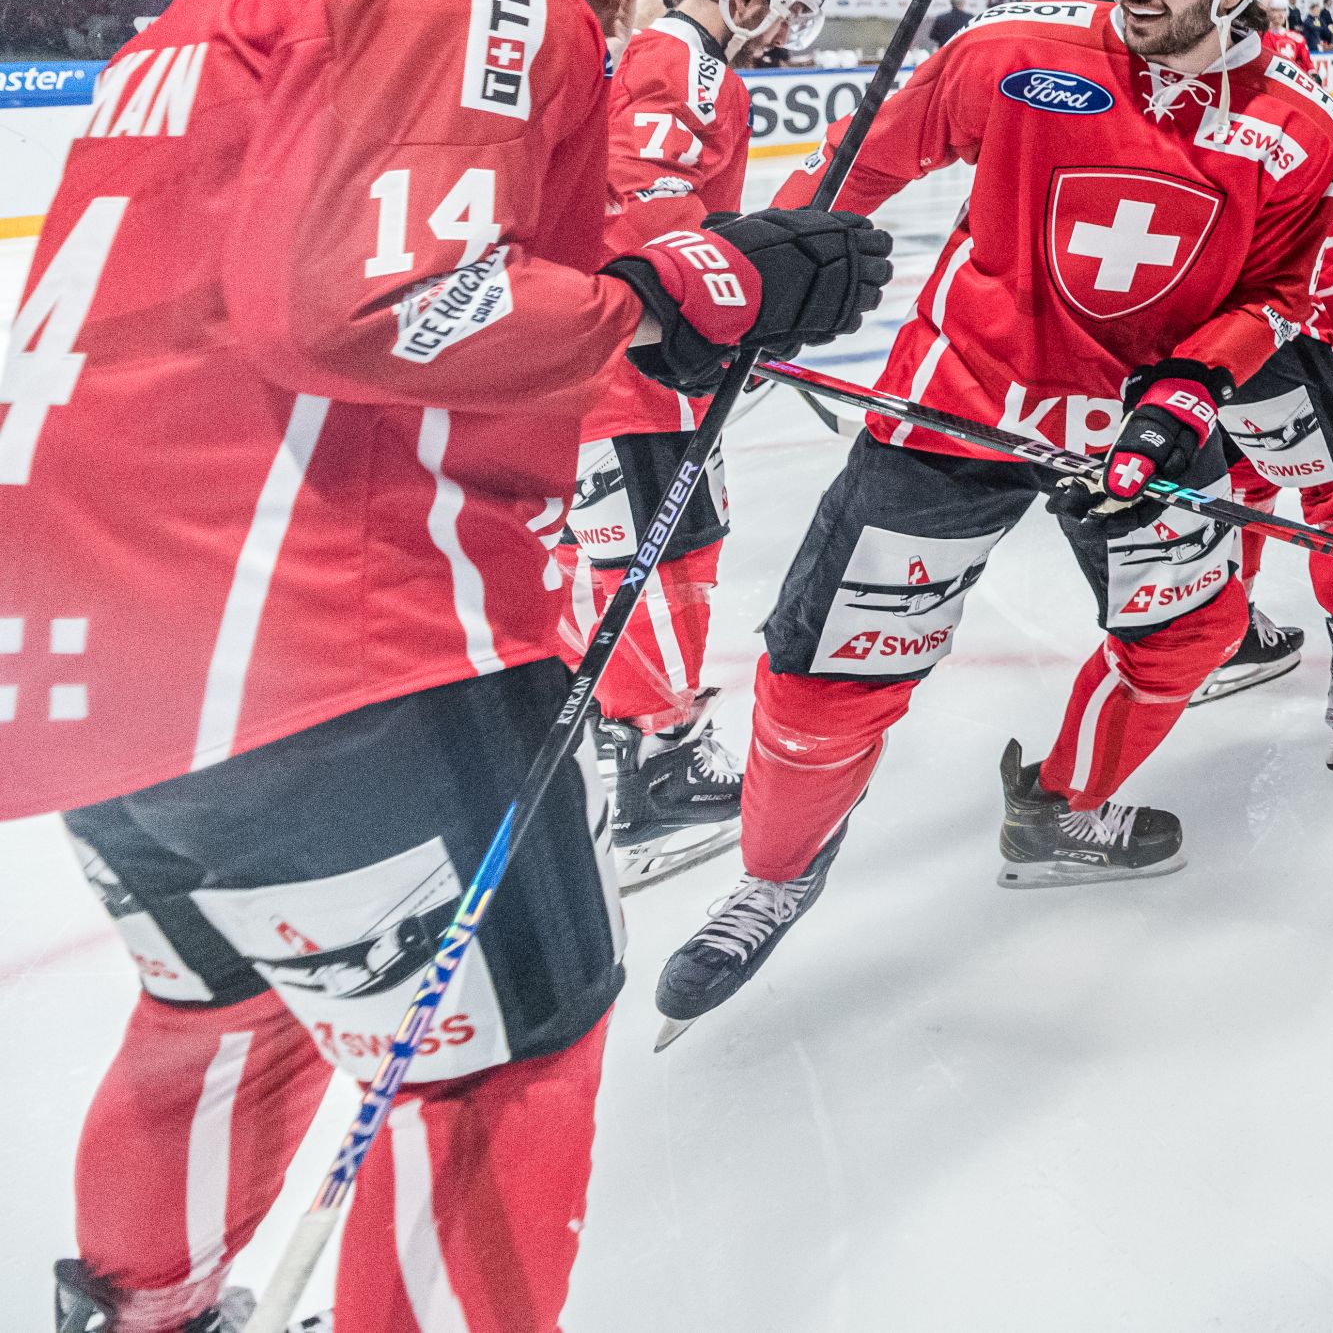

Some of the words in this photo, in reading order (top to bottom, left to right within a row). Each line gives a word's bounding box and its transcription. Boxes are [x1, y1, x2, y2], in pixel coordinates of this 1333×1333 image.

[1023, 73, 1093, 110] Ford
[1239, 127, 1295, 169] SWISS
[364, 167, 502, 279] 14
[472, 285, 504, 326] GAMES
[404, 314, 446, 358] ICE
[997, 379, 1128, 457] kp
[1272, 460, 1325, 478] SWISS
[1158, 568, 1222, 606] SWISS
[880, 625, 953, 657] SWISS
[556, 674, 594, 726] KUKAN
[1052, 849, 1100, 863] CCM
[342, 1014, 476, 1057] SWSS
